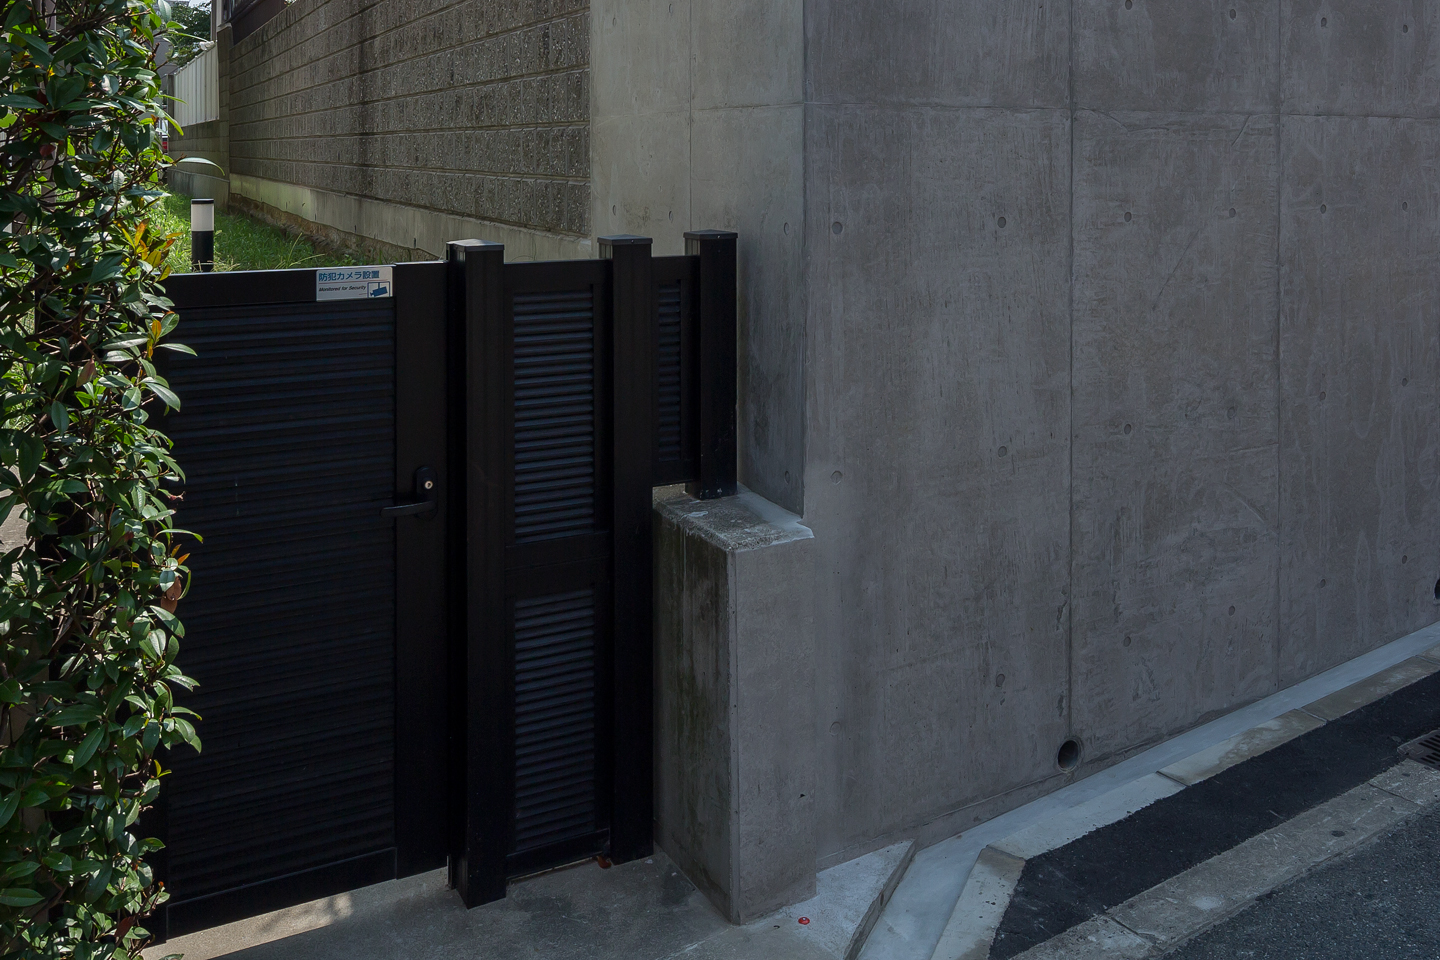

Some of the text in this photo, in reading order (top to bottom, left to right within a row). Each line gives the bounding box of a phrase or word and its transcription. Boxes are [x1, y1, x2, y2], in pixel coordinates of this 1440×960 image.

[318, 270, 380, 281] 防犯カメラ設置
